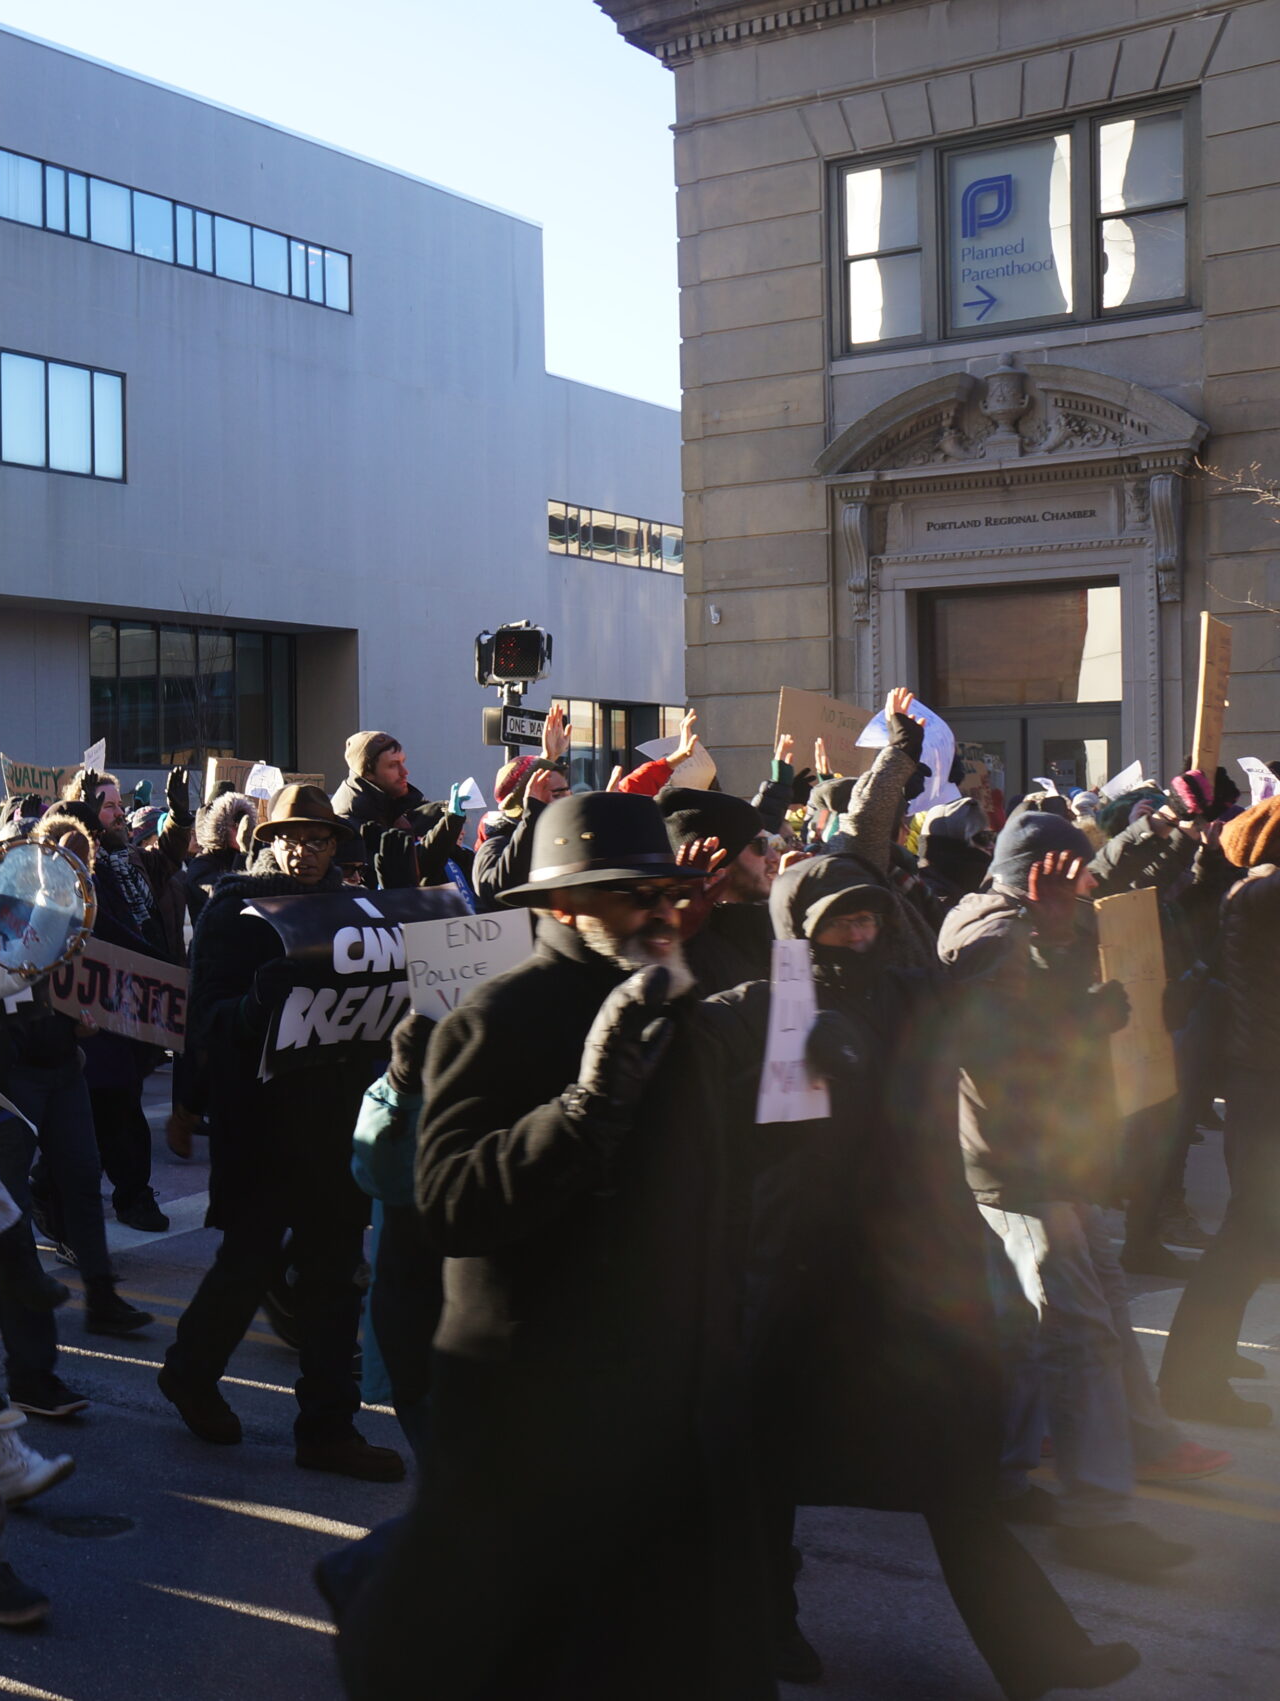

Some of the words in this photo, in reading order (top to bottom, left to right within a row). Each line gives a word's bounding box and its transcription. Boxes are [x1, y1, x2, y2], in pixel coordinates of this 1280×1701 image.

[962, 237, 1024, 262] Planned
[962, 254, 1054, 283] Parenthood
[926, 518, 981, 532] PORTLAND
[984, 513, 1039, 527] REGIONAL
[1042, 509, 1097, 523] CHAMBER
[509, 718, 526, 734] ONE
[529, 720, 544, 736] WA
[353, 898, 384, 919] I
[446, 918, 502, 949] END
[333, 925, 408, 975] CAN
[409, 959, 488, 989] POLICE
[77, 956, 186, 1036] JUSTICE
[276, 980, 411, 1052] BREAT
